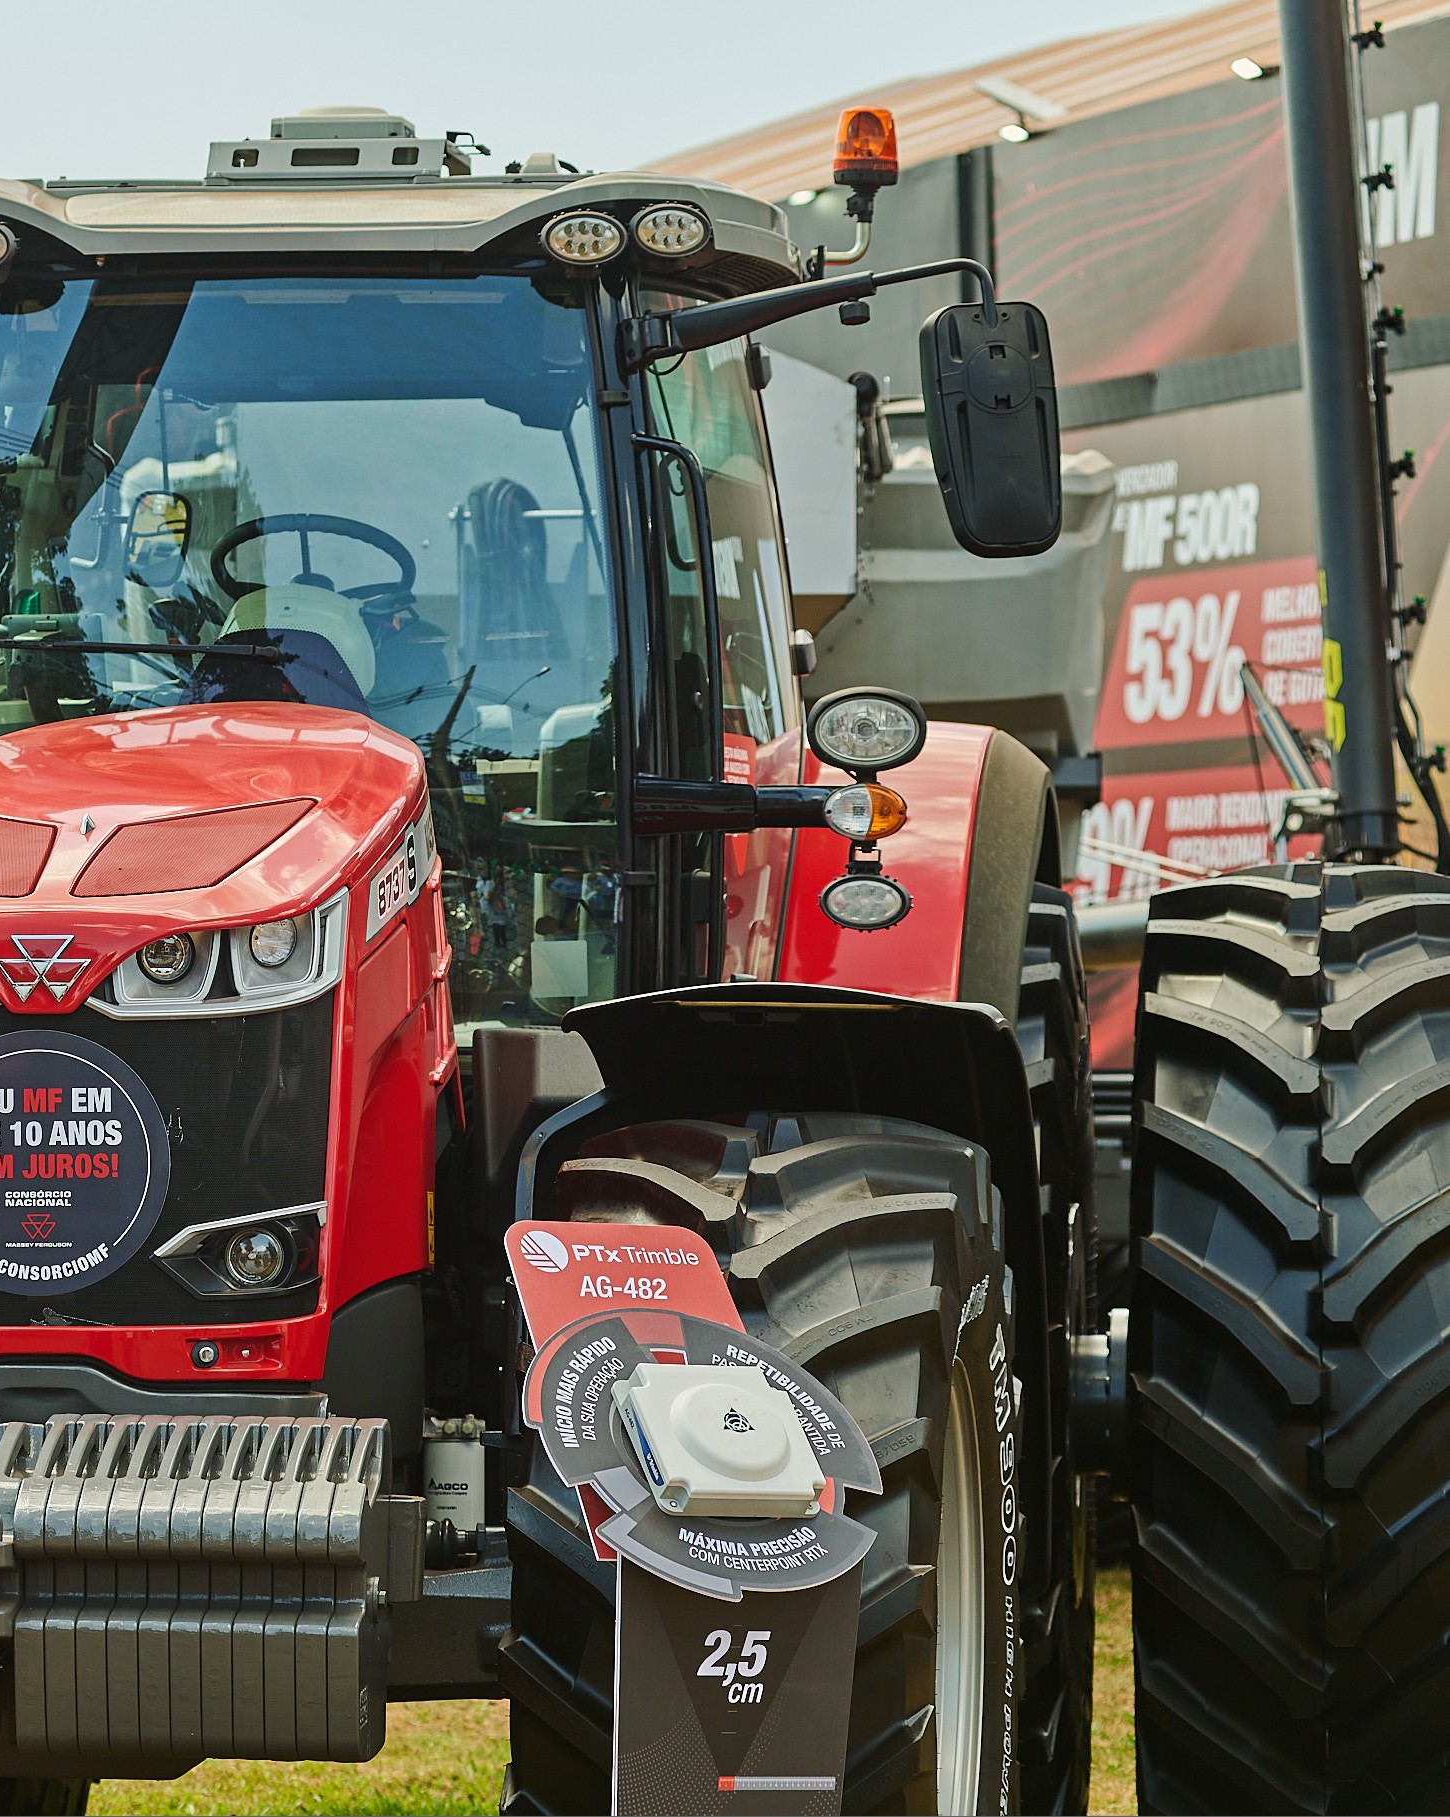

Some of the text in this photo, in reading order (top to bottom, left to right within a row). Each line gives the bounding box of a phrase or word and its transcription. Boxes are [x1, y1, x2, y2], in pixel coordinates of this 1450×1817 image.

[1173, 482, 1259, 565] 500R
[1123, 589, 1247, 724] 53%
[378, 832, 417, 919] 8737 S
[23, 1088, 62, 1113] MF
[71, 1087, 112, 1113] EM
[10, 1121, 43, 1146] 10
[49, 1120, 123, 1146] ANOS
[22, 1153, 119, 1178] JUROS!
[5, 1190, 72, 1198] CONSÓRCIO
[5, 1199, 72, 1207] NACIONAL
[571, 1244, 699, 1266] PTx Trimble
[579, 1275, 668, 1300] AG-482
[828, 1322, 854, 1337] 900
[555, 1336, 617, 1448] INÍCIO MAIS RÁPIDO
[580, 1357, 625, 1441] DA SUA OPERAÇÃO
[726, 1344, 846, 1449] REPETIBILIDADE DE
[793, 1404, 831, 1456] RANTIDA
[678, 1526, 817, 1557] MÁXIMA PRECISÃO
[688, 1543, 829, 1571] COM CENTERPOINT RTX
[696, 1629, 772, 1687] 2,5
[728, 1682, 764, 1704] cm
[1000, 1703, 1012, 1816] POWE
